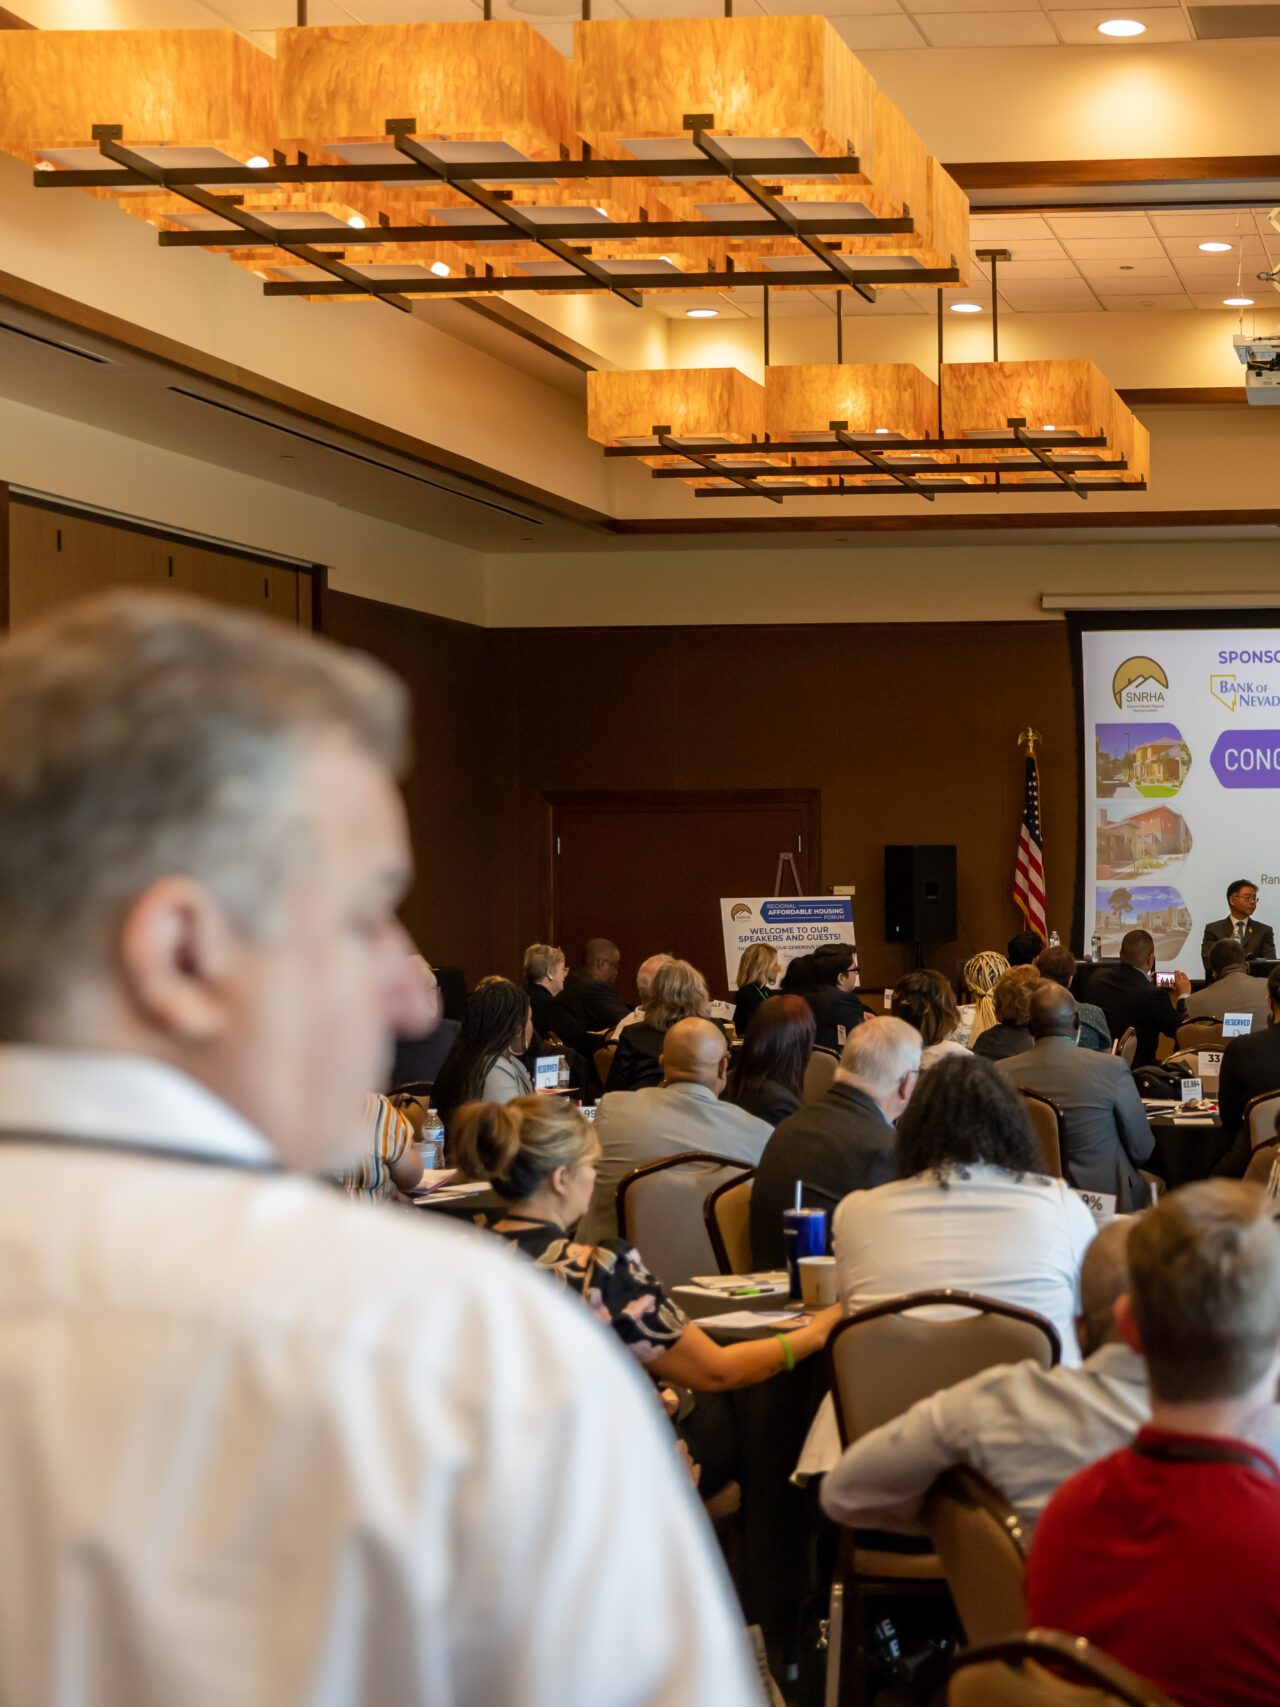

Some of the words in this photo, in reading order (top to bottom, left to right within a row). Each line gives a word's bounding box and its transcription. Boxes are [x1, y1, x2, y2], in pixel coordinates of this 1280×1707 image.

[1219, 680, 1254, 694] BANK
[1126, 691, 1165, 703] SNRHA
[750, 927, 795, 935] WELCOME
[738, 934, 784, 943] SPEAKERS
[806, 933, 841, 941] GUESTS!
[1224, 1018, 1251, 1026] RESERVED
[1207, 1054, 1220, 1063] 33
[537, 1063, 558, 1074] RESERVED
